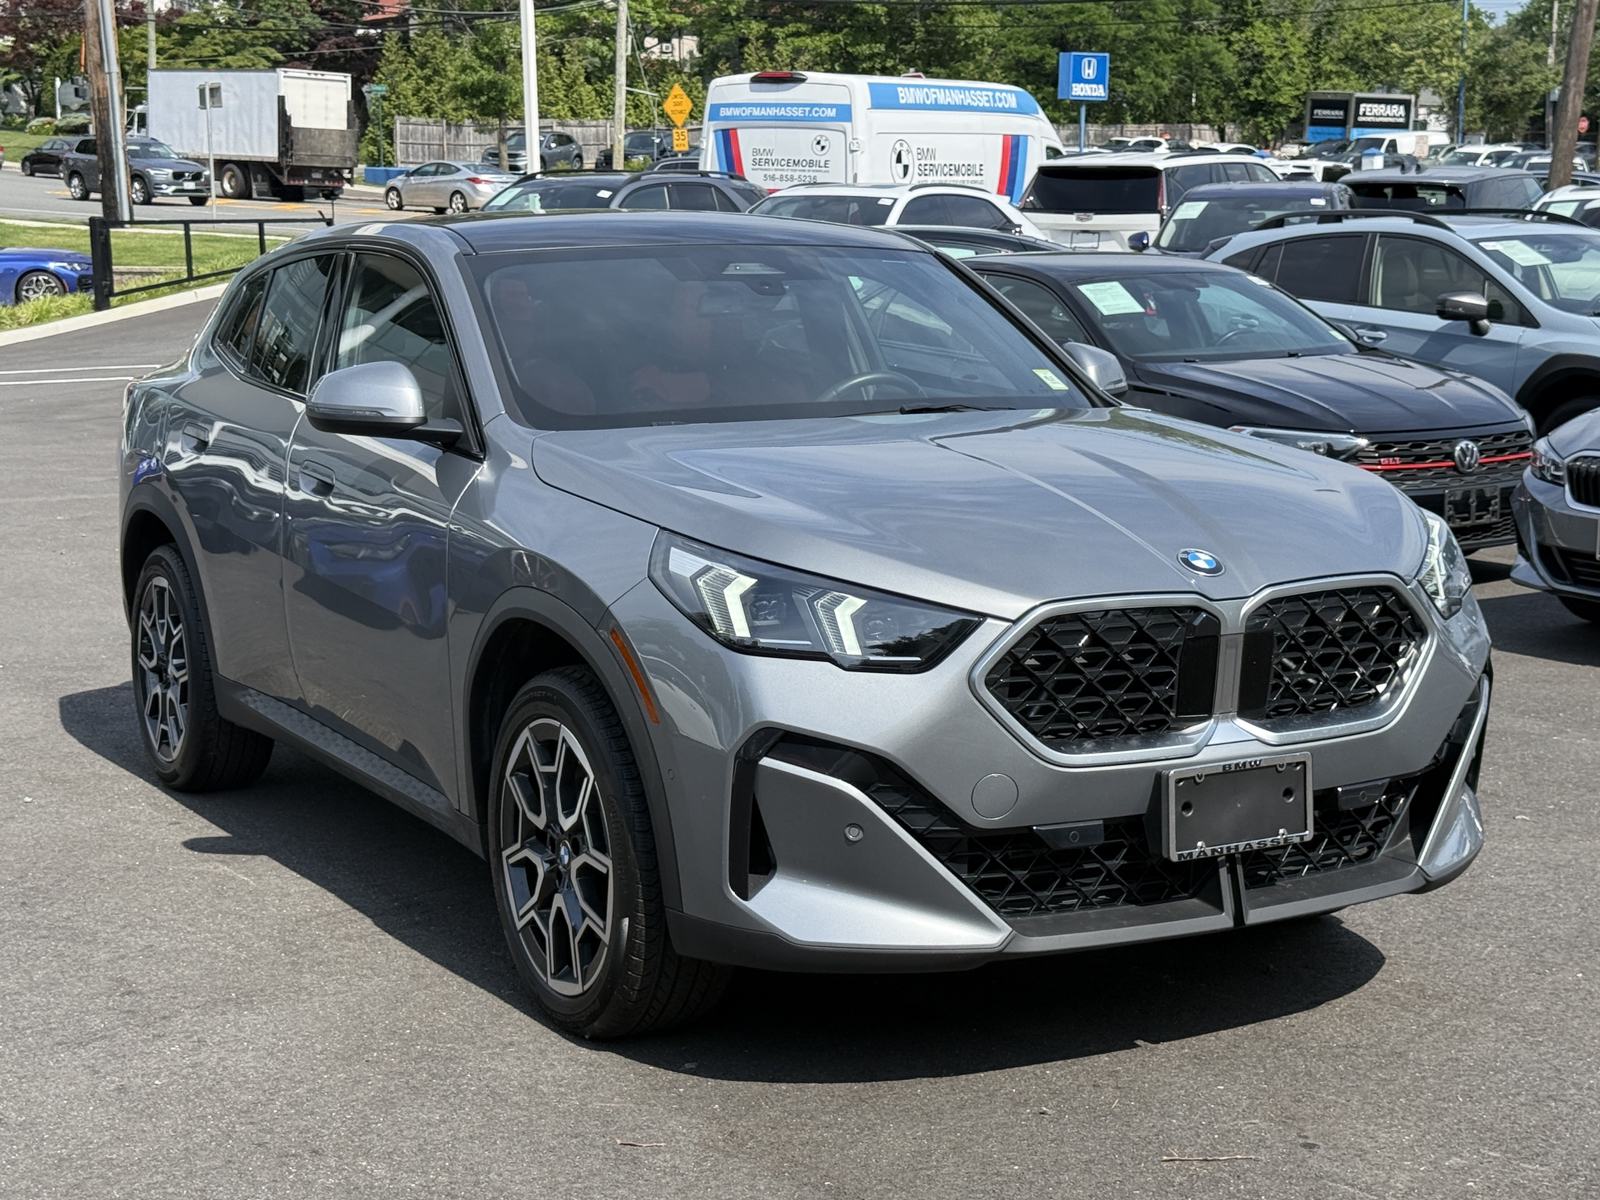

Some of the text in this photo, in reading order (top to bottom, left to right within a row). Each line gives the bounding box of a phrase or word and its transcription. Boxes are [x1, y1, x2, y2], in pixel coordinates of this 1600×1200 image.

[1071, 83, 1106, 97] HONDA
[897, 87, 1018, 110] BMWOFMANHASSET.COM
[719, 106, 837, 119] BMWOFMANHASSET.COM
[1359, 103, 1406, 117] FERRARA
[674, 131, 687, 142] 35
[751, 147, 774, 157] BMW
[916, 147, 937, 161] BMW
[751, 158, 831, 169] SERVICEMOBILE
[917, 163, 984, 177] SERVICEMOBILE
[763, 173, 818, 184] 516-858-5236
[1222, 759, 1263, 772] BMW
[1177, 834, 1306, 862] MANHASSET
